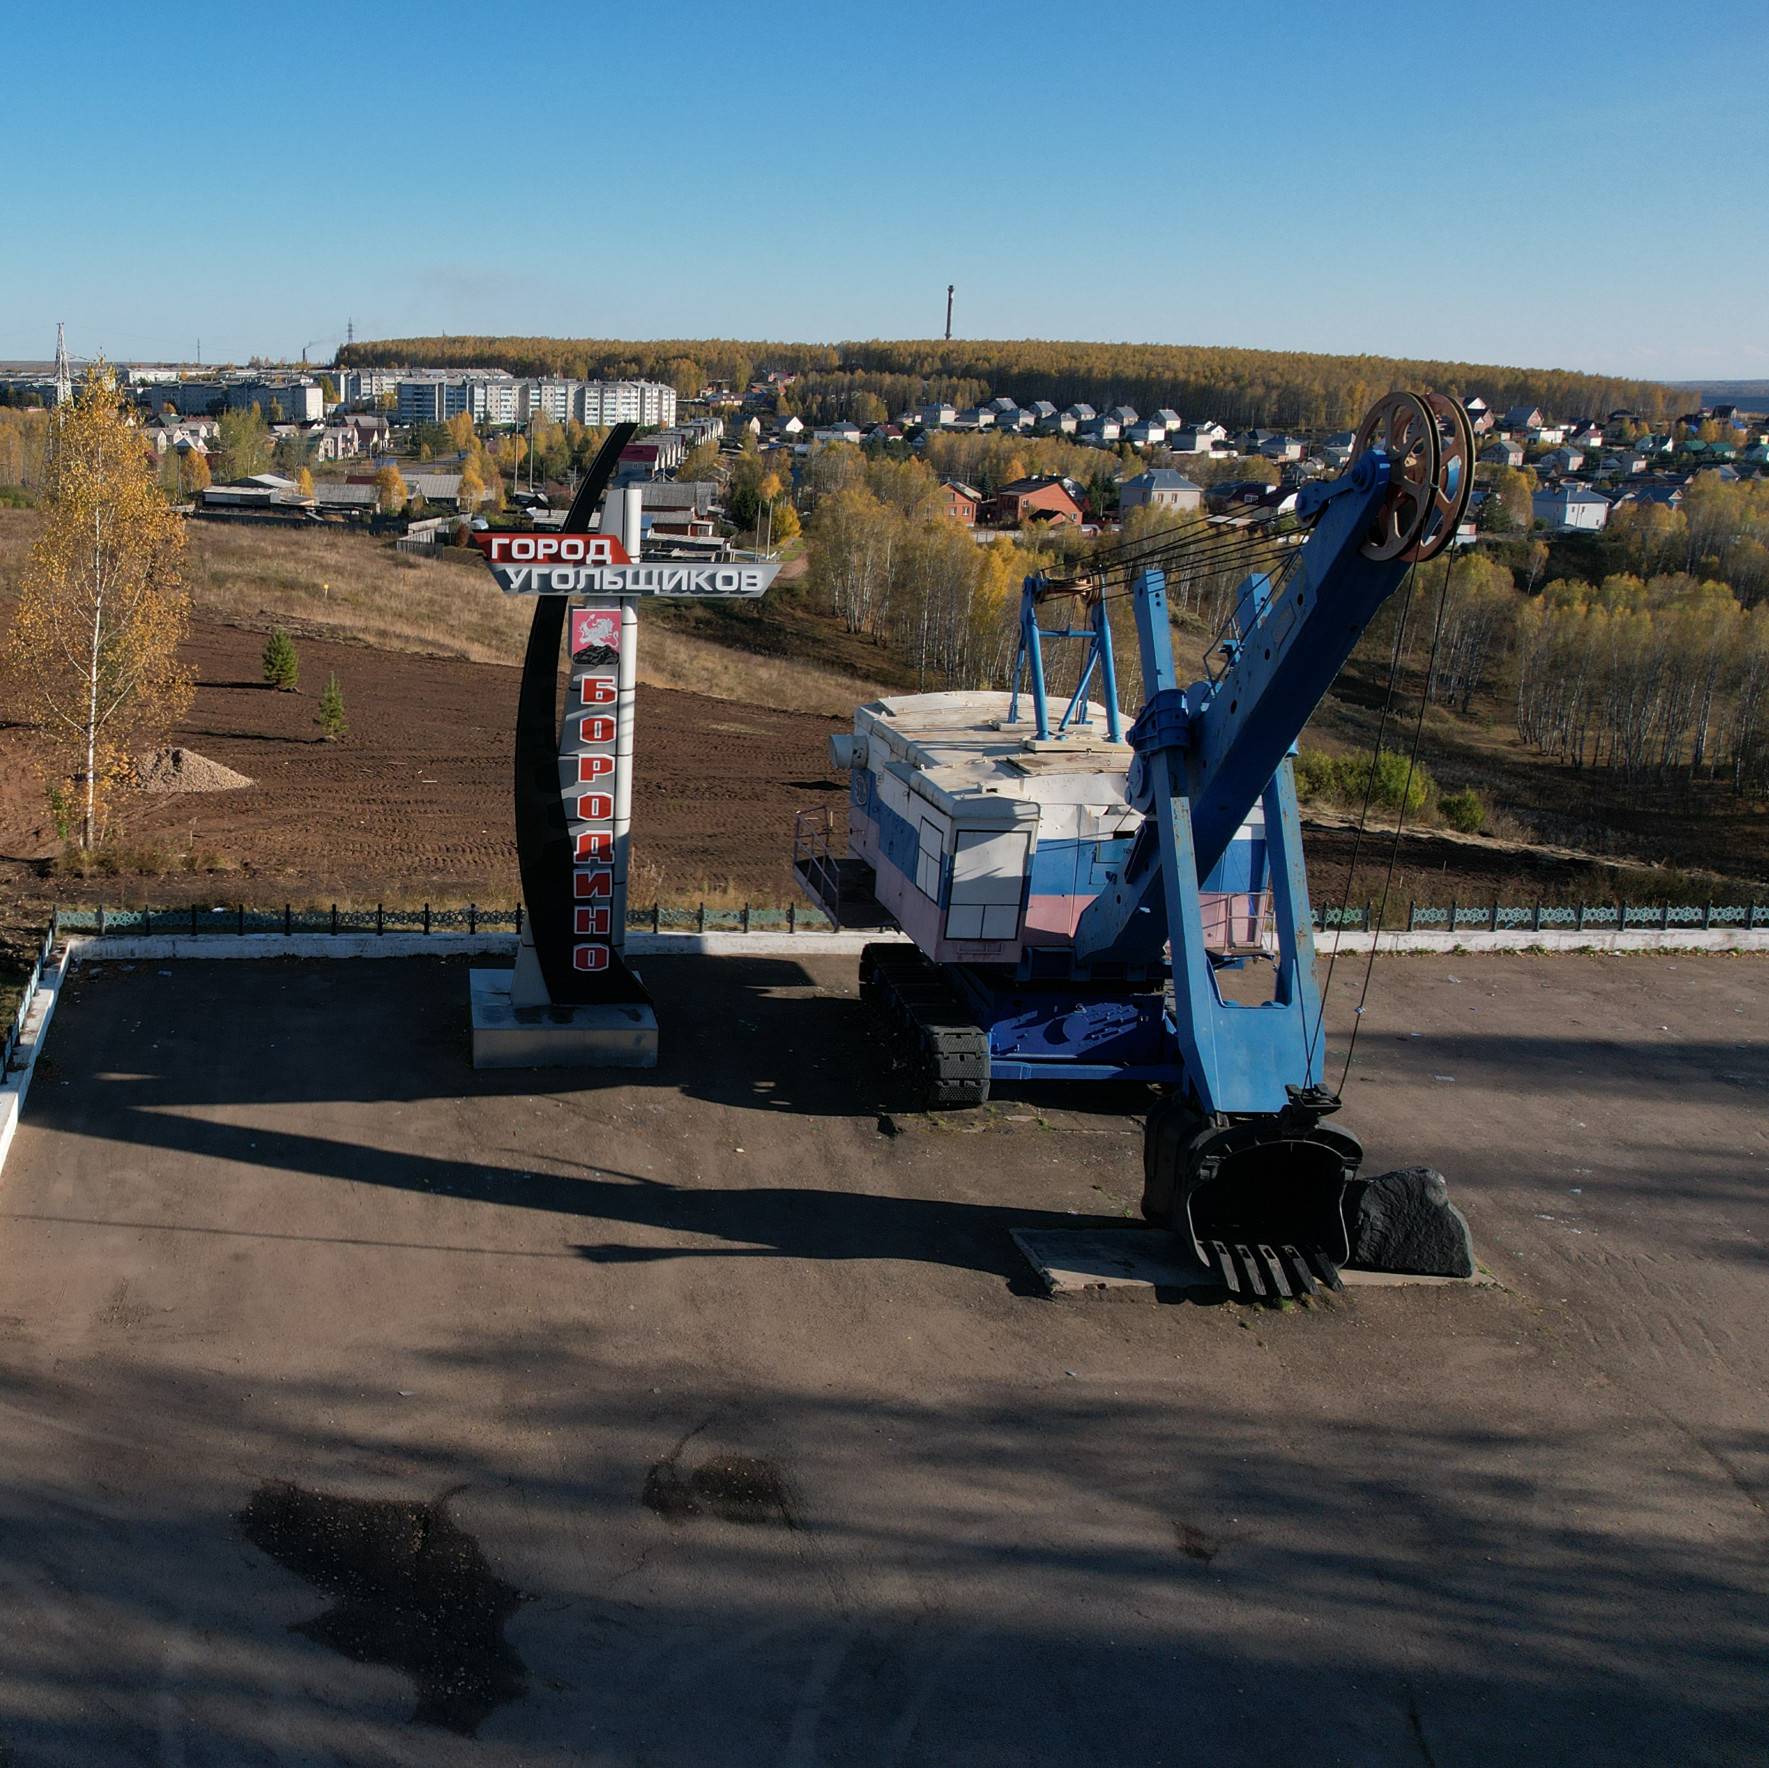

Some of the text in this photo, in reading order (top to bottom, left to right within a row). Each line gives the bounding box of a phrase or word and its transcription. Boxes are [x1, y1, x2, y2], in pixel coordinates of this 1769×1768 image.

[491, 538, 613, 565] ГОРОД
[505, 567, 764, 594] УГОЛЬЩИКОВ
[573, 675, 617, 972] БОРОДИНО
